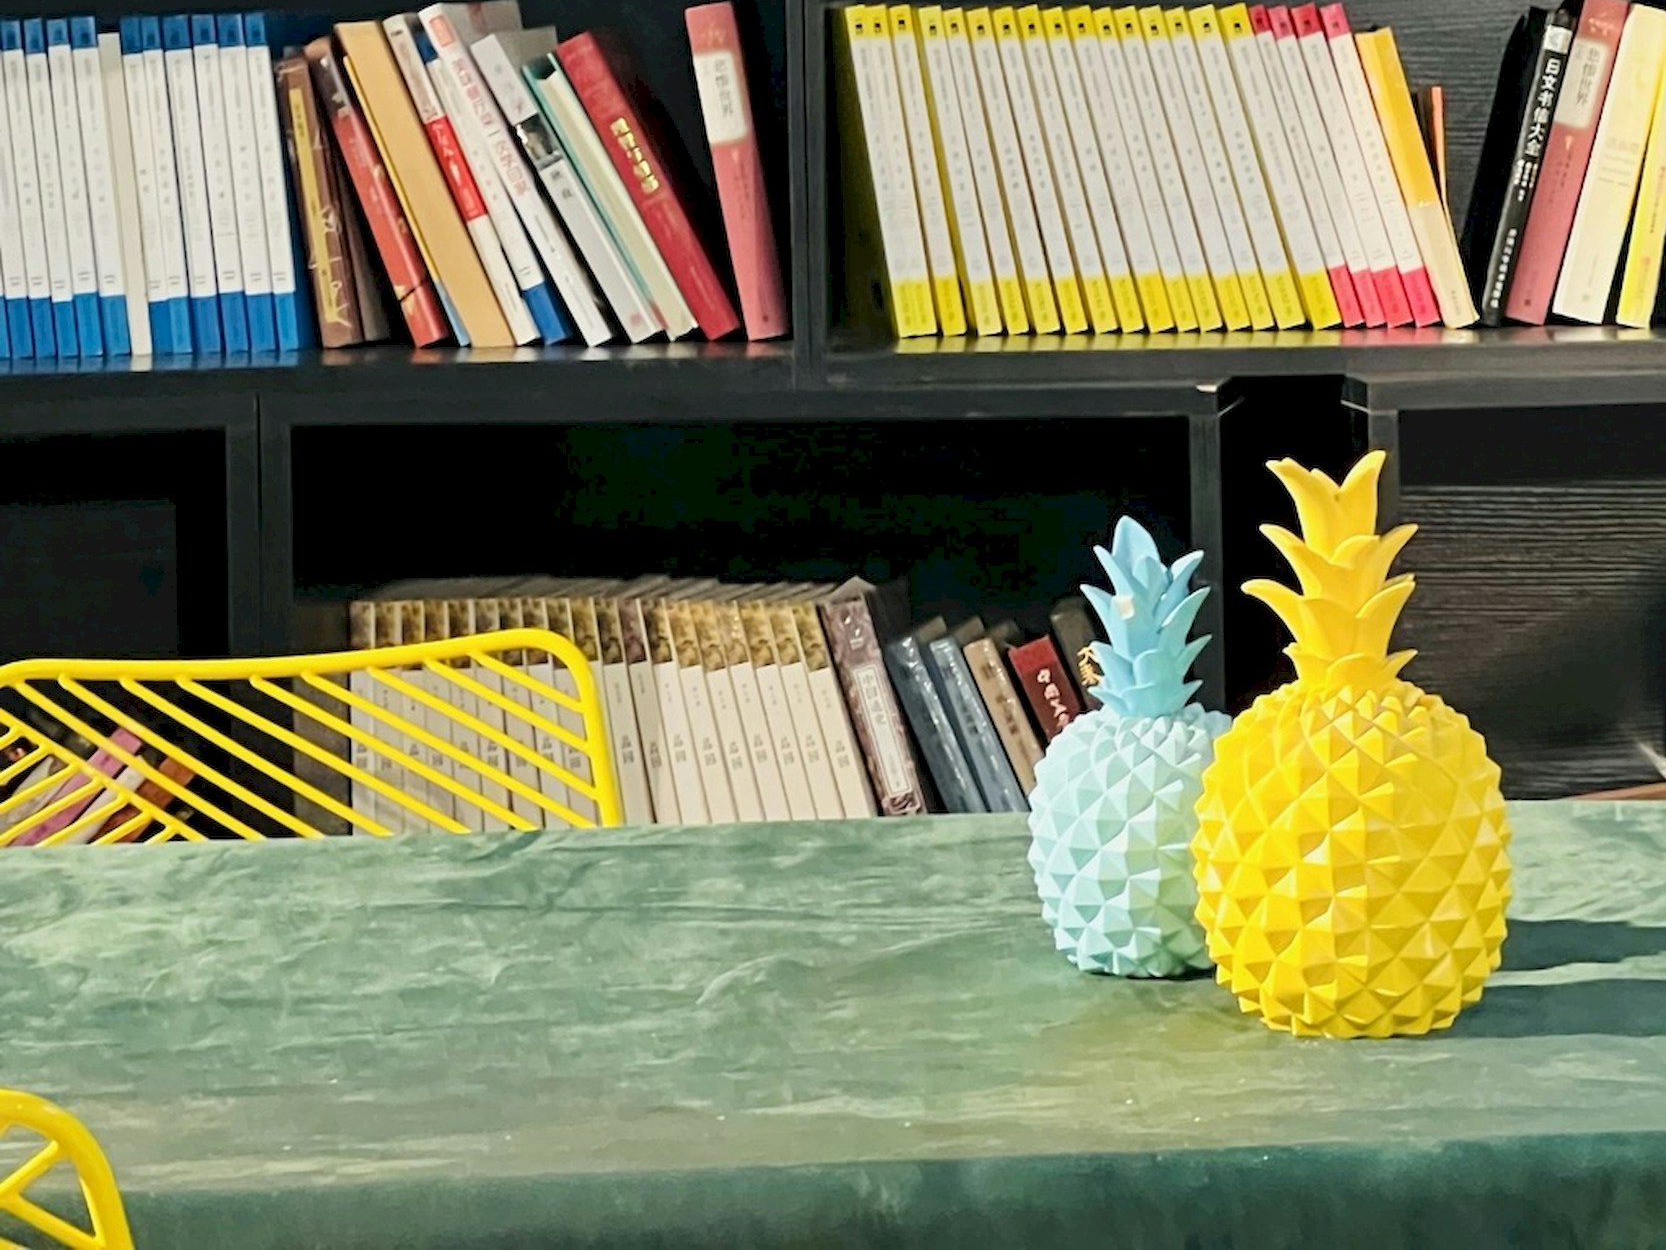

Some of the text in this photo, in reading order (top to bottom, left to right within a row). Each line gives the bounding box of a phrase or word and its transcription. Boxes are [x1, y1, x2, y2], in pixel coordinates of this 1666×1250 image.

[1525, 56, 1562, 166] 日文书信大全
